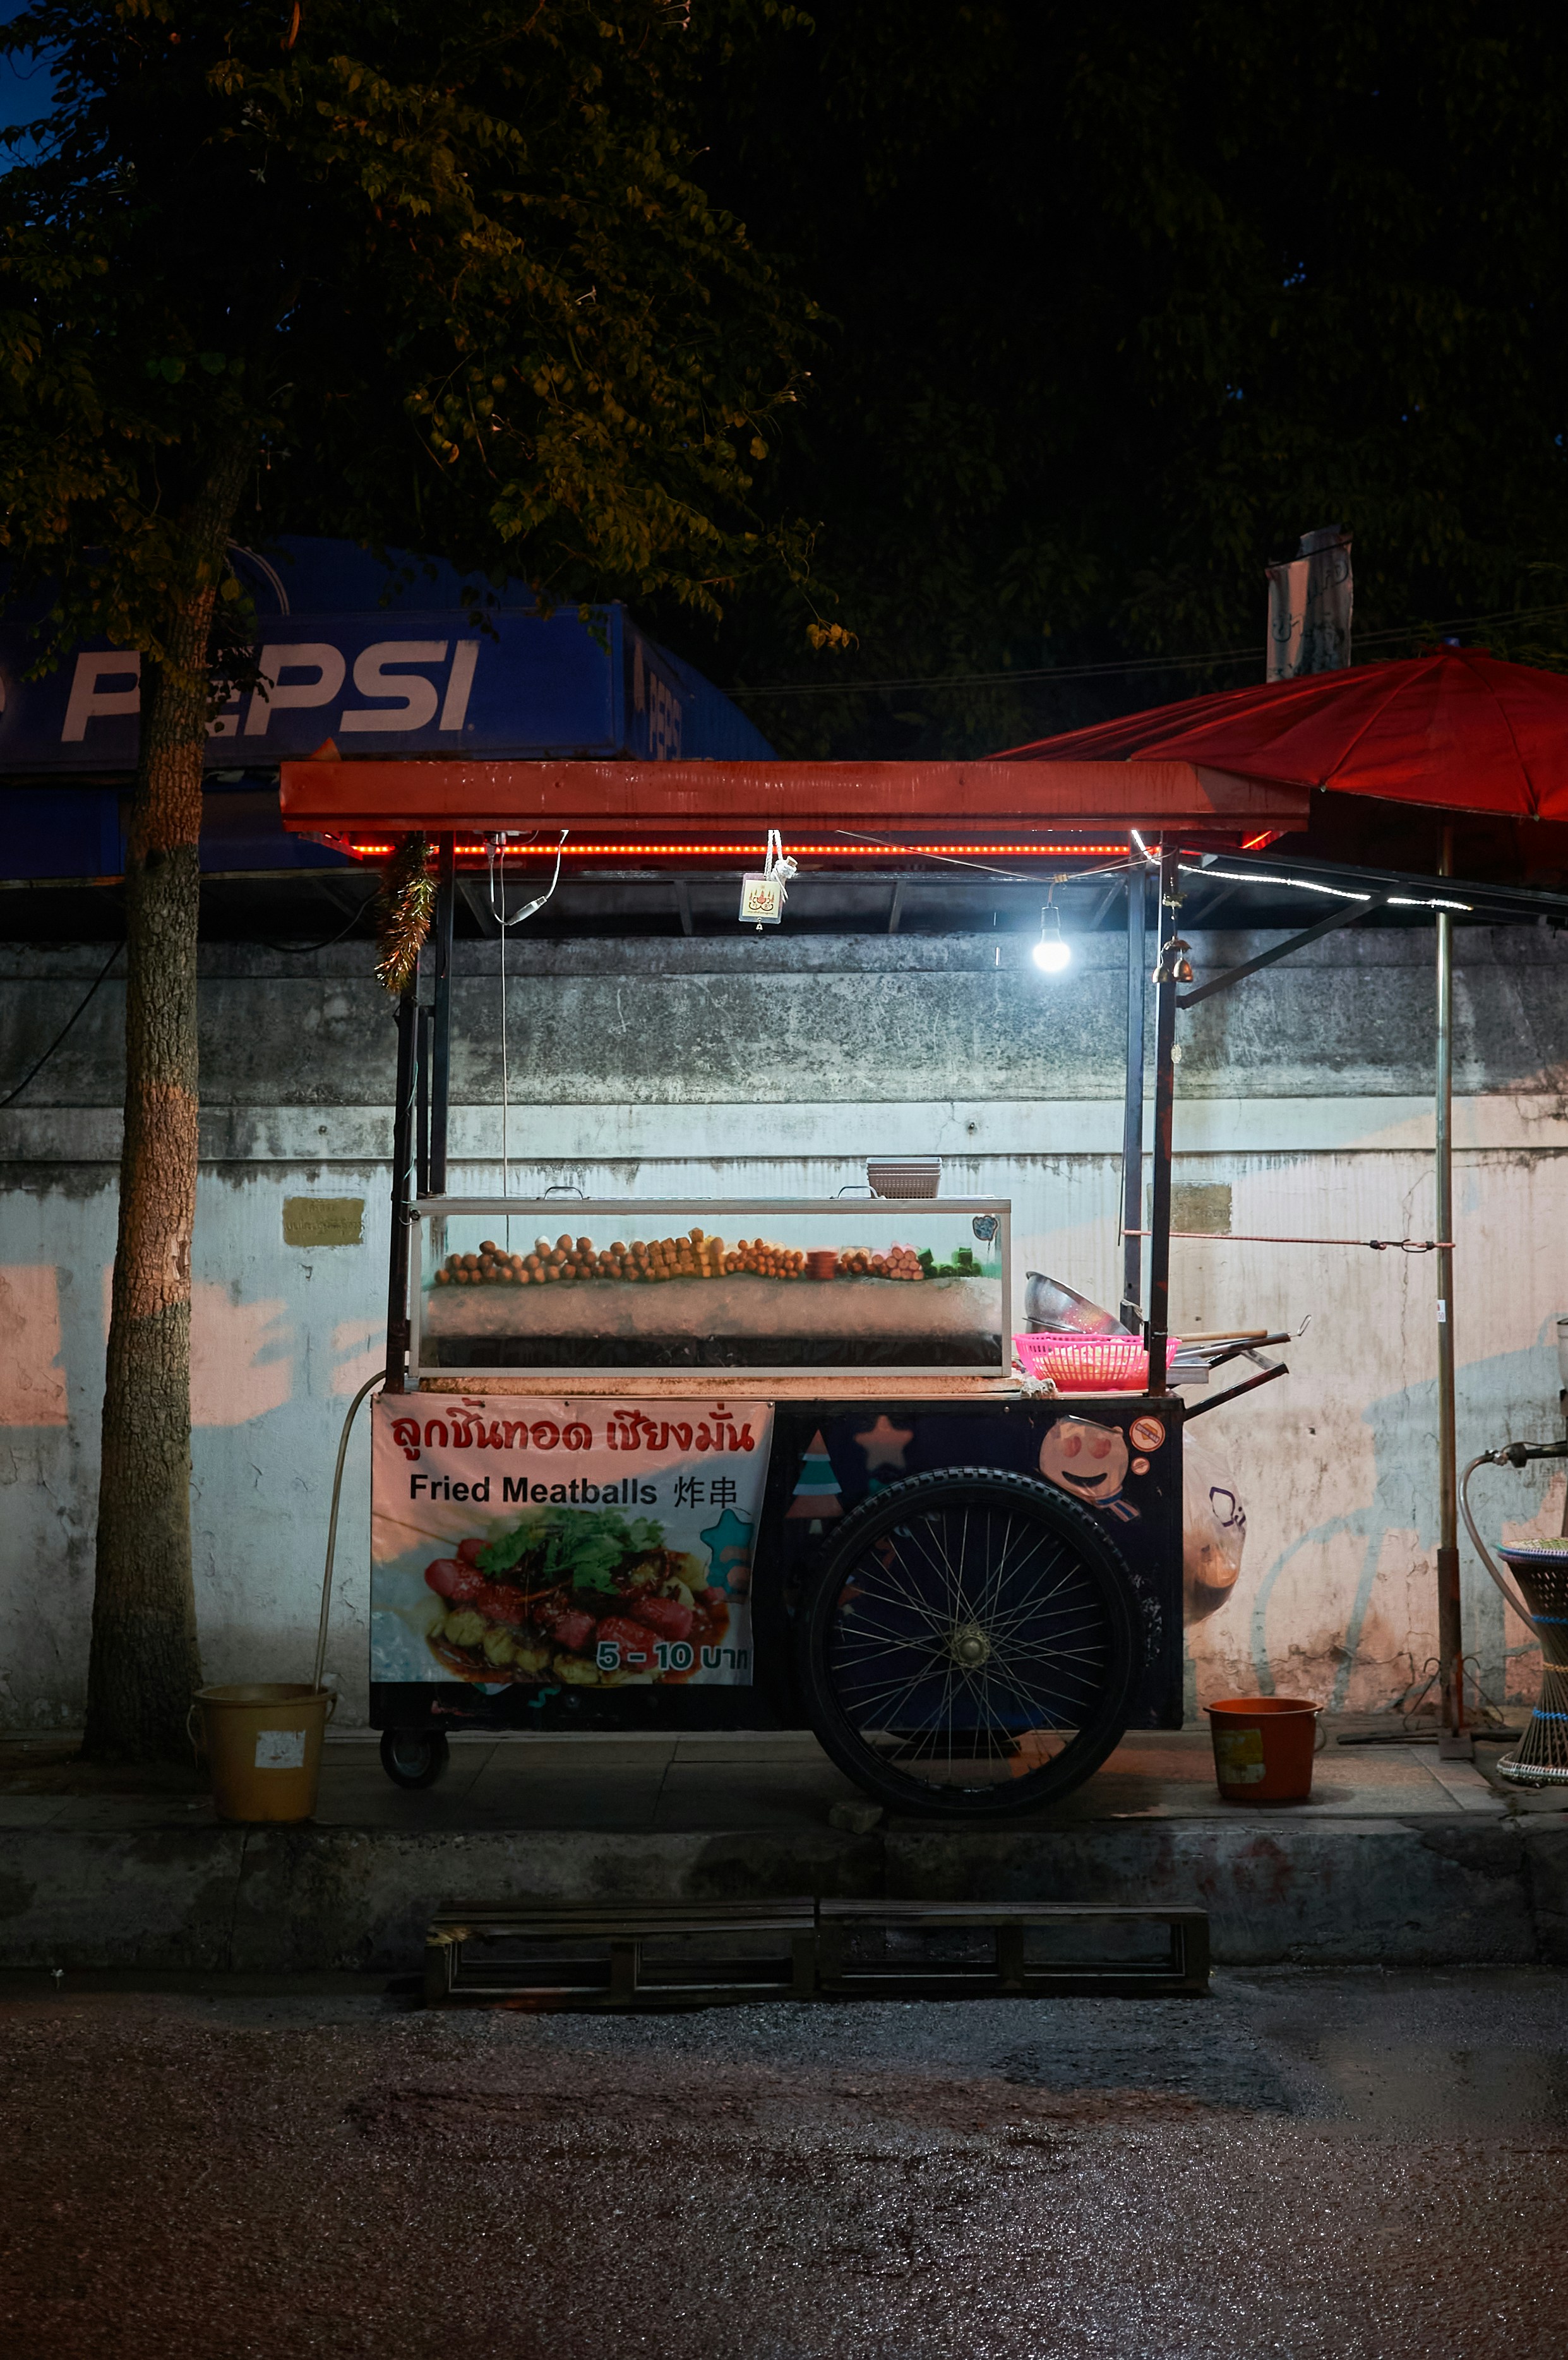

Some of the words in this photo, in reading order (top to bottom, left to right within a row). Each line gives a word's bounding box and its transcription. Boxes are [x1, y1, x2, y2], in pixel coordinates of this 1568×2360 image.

[390, 1397, 592, 1461] ลูกชิ้นทอด
[607, 1403, 755, 1451] เชียงมั่น
[410, 1474, 489, 1502] Fried
[503, 1476, 657, 1504] Meatballs
[674, 1476, 737, 1509] 炸串
[597, 1642, 619, 1670] 5
[654, 1642, 693, 1670] 10
[701, 1646, 748, 1669] บาท
